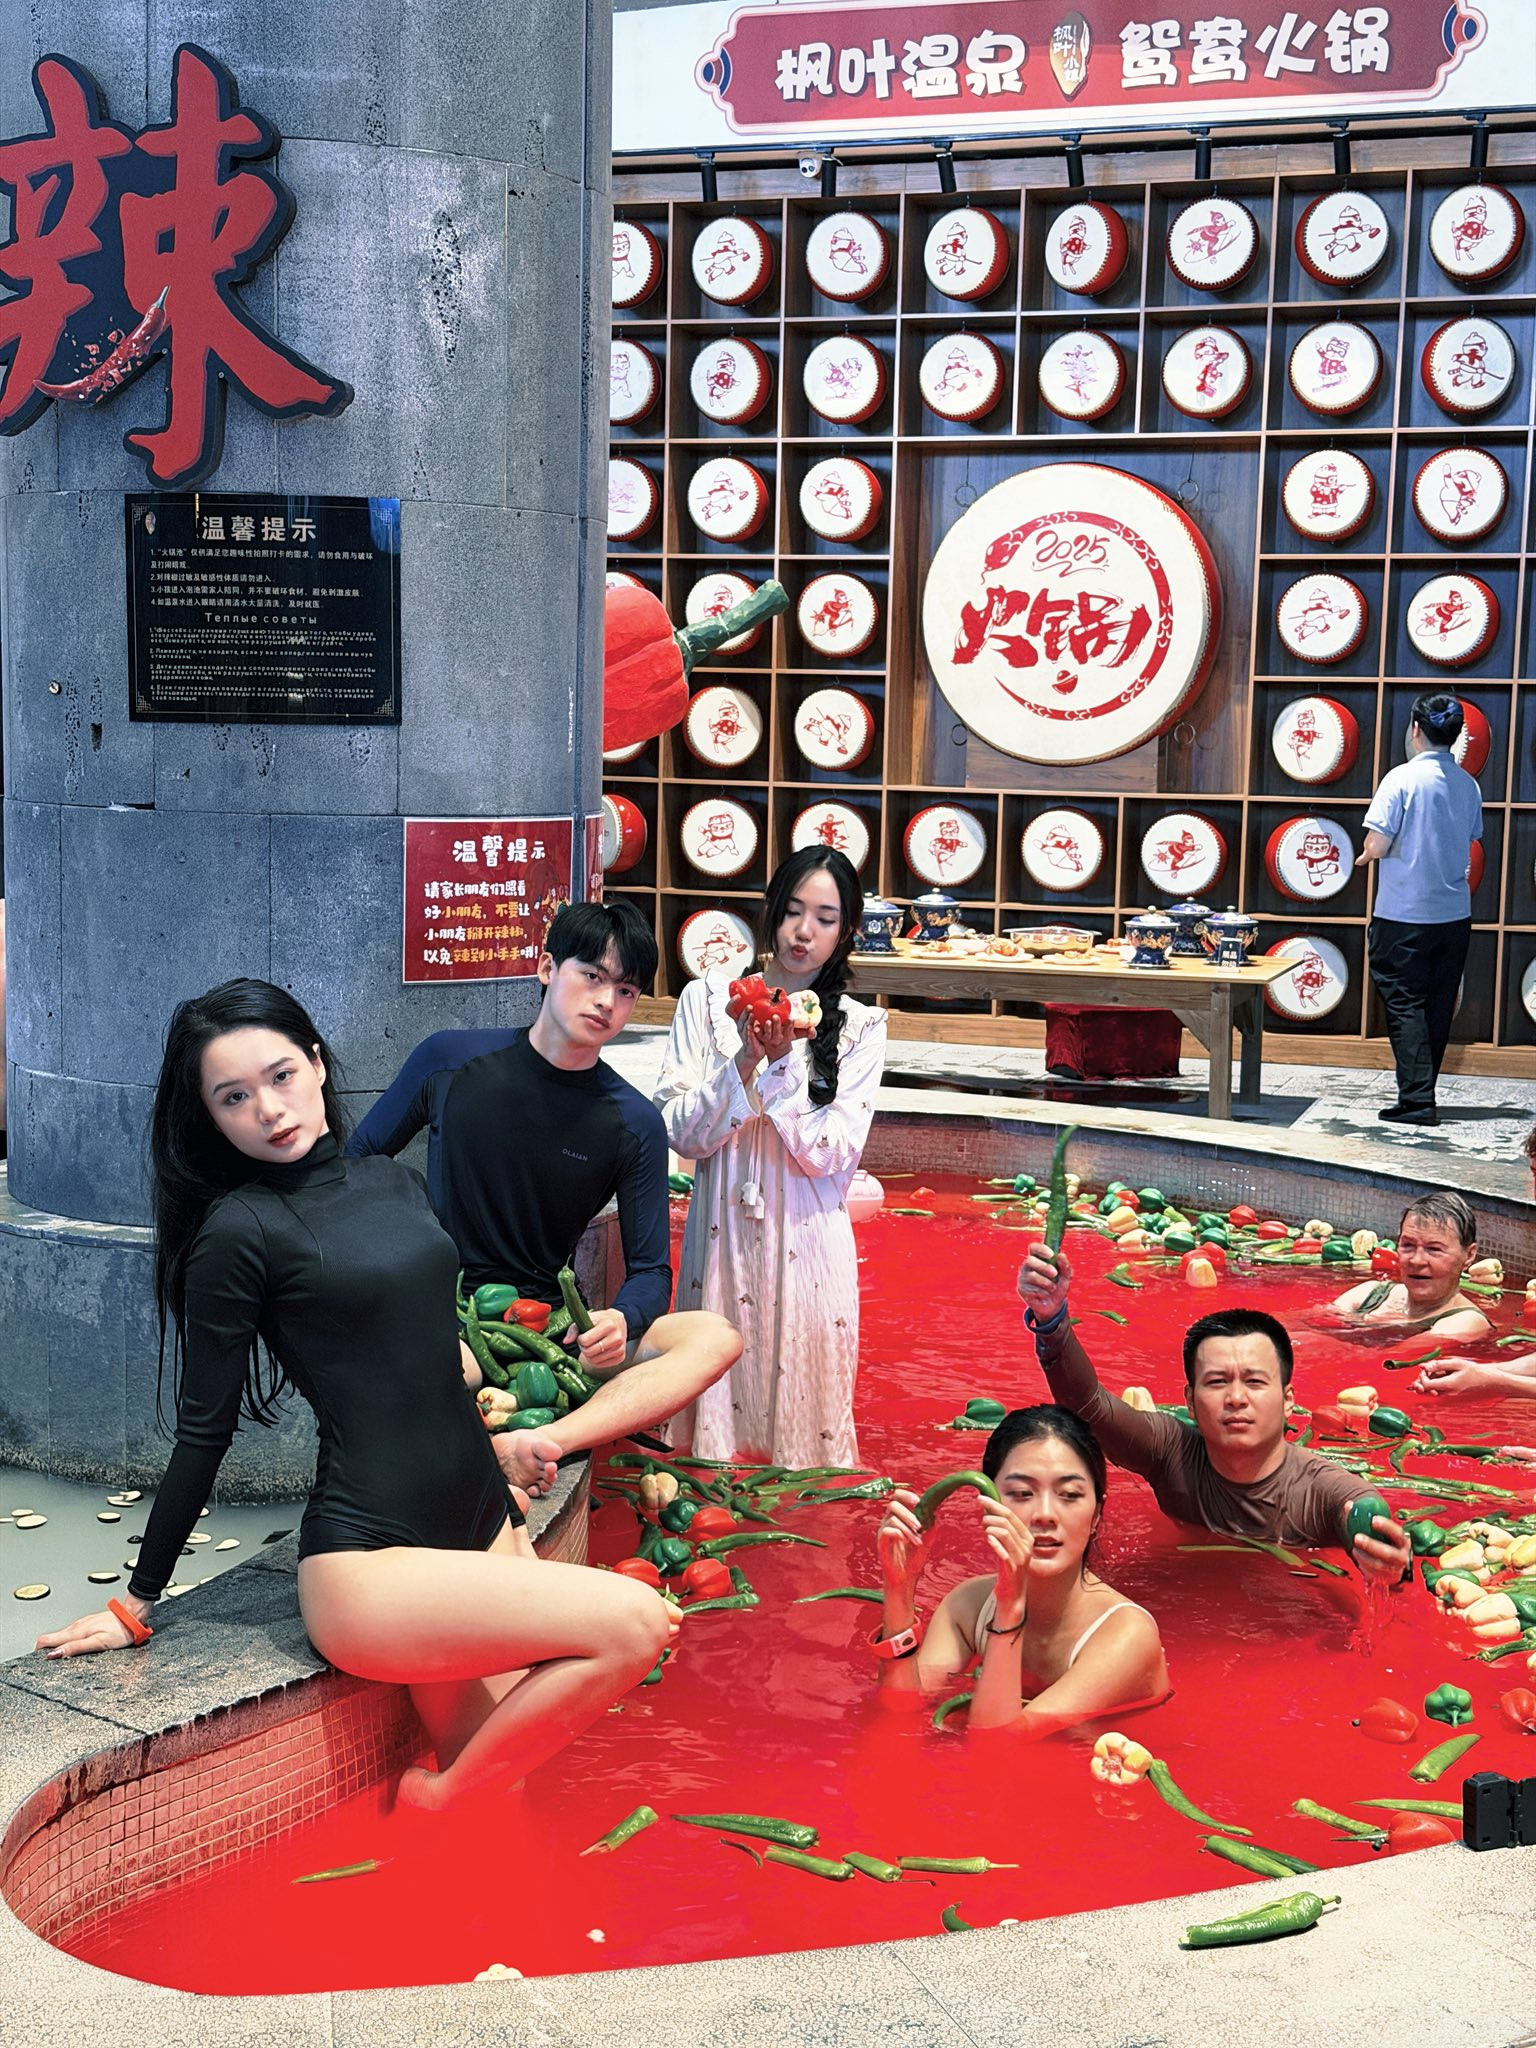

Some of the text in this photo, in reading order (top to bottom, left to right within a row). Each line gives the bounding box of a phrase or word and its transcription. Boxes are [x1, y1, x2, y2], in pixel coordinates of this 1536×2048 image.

[774, 7, 1389, 100] 枫叶温泉 鸳鸯火锅
[0, 48, 336, 480] 辣
[201, 515, 317, 542] 温馨提示
[1034, 530, 1111, 564] 2025
[205, 612, 317, 625] Теплые советы
[950, 584, 1153, 669] 火锅
[452, 835, 546, 867] 温馨提示
[424, 879, 527, 899] 请家长朋友们照看
[424, 901, 531, 920] 好小朋友，不要让
